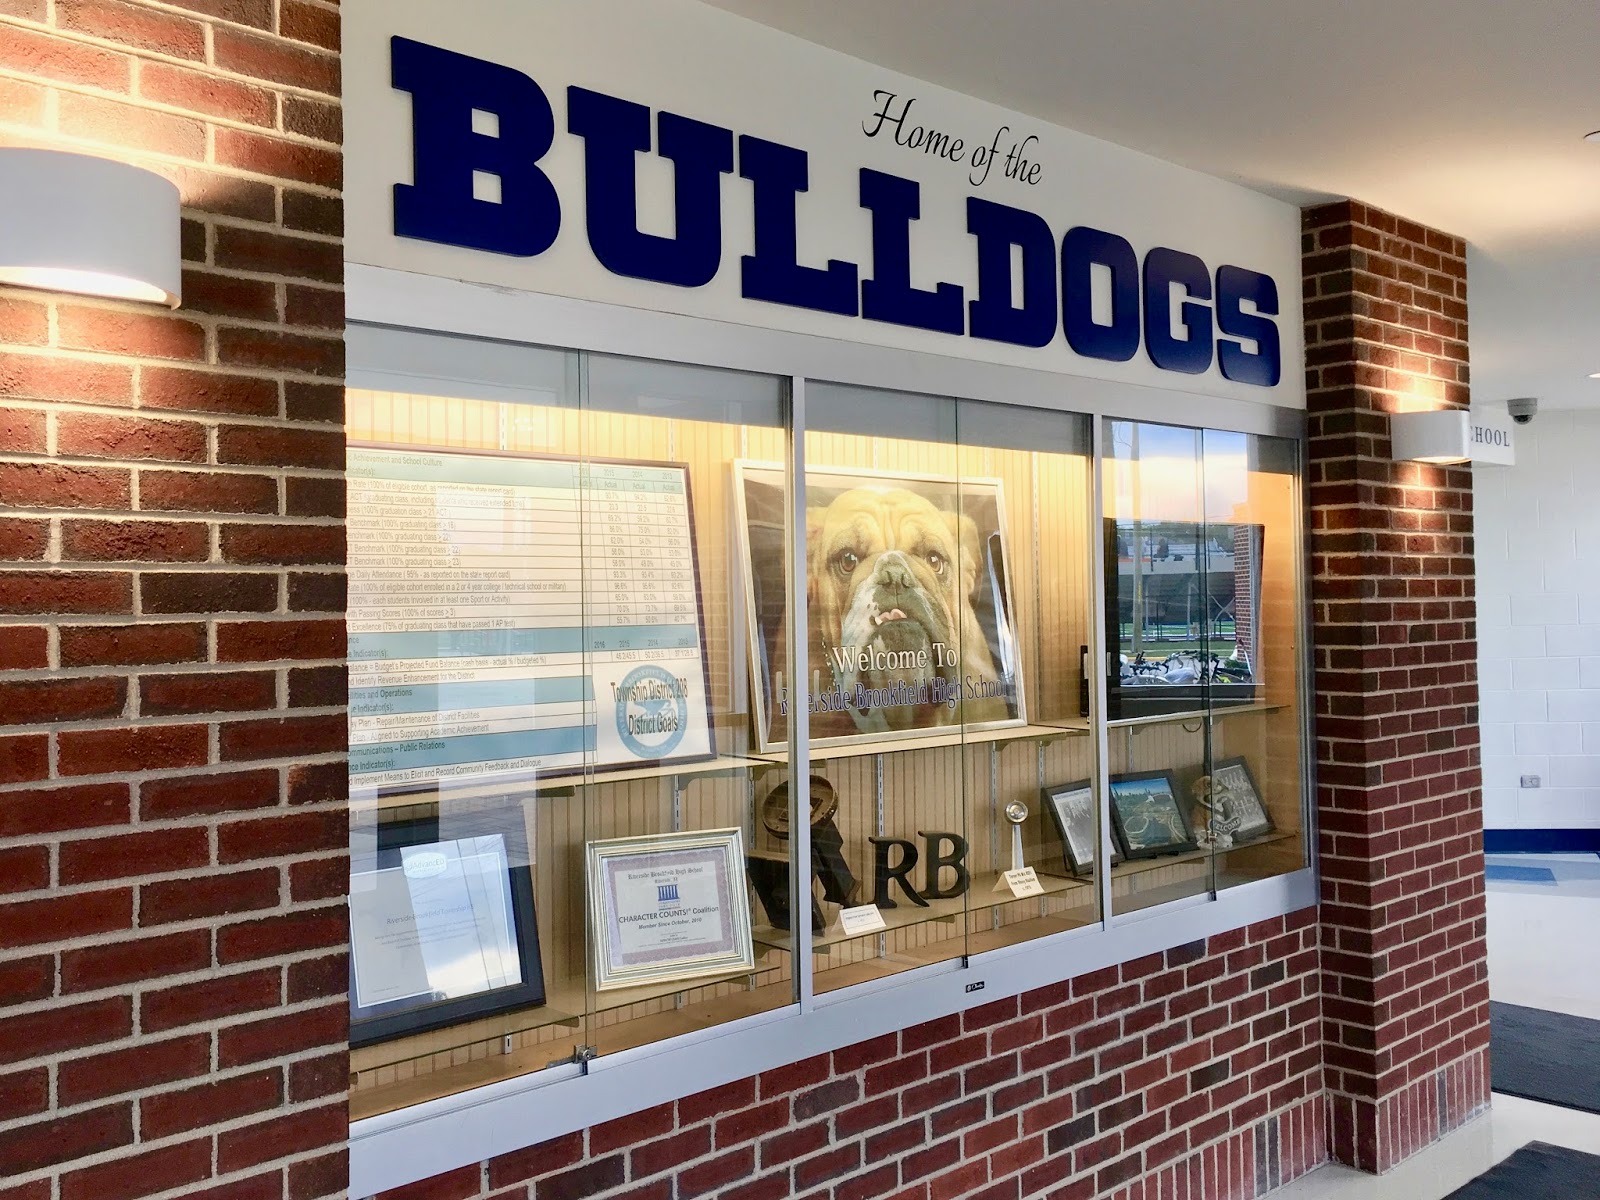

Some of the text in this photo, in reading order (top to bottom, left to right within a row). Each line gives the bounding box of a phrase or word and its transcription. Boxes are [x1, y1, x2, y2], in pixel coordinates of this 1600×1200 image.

[861, 89, 1043, 187] Home of the
[391, 36, 1281, 387] BULLDOGS
[353, 453, 442, 467] Achievement and School Culture
[355, 544, 385, 552] Benchmark
[405, 545, 432, 555] graduating
[434, 545, 446, 553] class
[355, 557, 385, 565] Benchmark
[405, 557, 432, 567] graduating
[434, 558, 447, 566] class
[356, 570, 369, 580] Daily
[372, 570, 402, 578] Attendance
[431, 571, 452, 580] reported
[386, 582, 405, 593] eligible
[406, 582, 423, 590] cohort
[424, 582, 444, 590] enrolled
[472, 584, 482, 592] year
[483, 582, 501, 592] college
[504, 582, 526, 590] technical
[527, 582, 542, 590] school
[387, 596, 410, 604] students
[470, 595, 483, 605] Sport
[359, 609, 380, 620] Passing
[382, 609, 401, 618] Scores
[426, 609, 444, 617] scores
[352, 622, 381, 630] Excellence
[405, 621, 432, 631] graduating
[448, 620, 457, 628] that
[458, 620, 471, 628] have
[472, 620, 490, 629] passed
[353, 649, 389, 658] Indicator(s):
[832, 642, 958, 673] Welcome To
[378, 676, 402, 685] Revenue
[404, 674, 439, 683] Enhancement
[380, 689, 412, 699] Operations
[611, 678, 688, 702] Township District 208
[855, 681, 928, 710] Brookfield
[931, 676, 963, 709] High
[966, 674, 1008, 700] School
[358, 703, 394, 713] Indicator(s):
[629, 714, 655, 735] District
[657, 712, 678, 732] Goals
[400, 728, 429, 739] Supporting
[456, 724, 489, 733] Achievement
[400, 741, 445, 752] Public Relations
[360, 760, 395, 770] Indicator(s):
[354, 774, 383, 786] Implement
[384, 772, 403, 781] Means
[436, 768, 455, 777] Record
[456, 766, 484, 776] Community
[485, 762, 510, 772] Feedback
[510, 761, 520, 769] and
[521, 759, 542, 769] Dialogue
[619, 912, 658, 924] CHARACTER
[693, 906, 719, 914] Coalition
